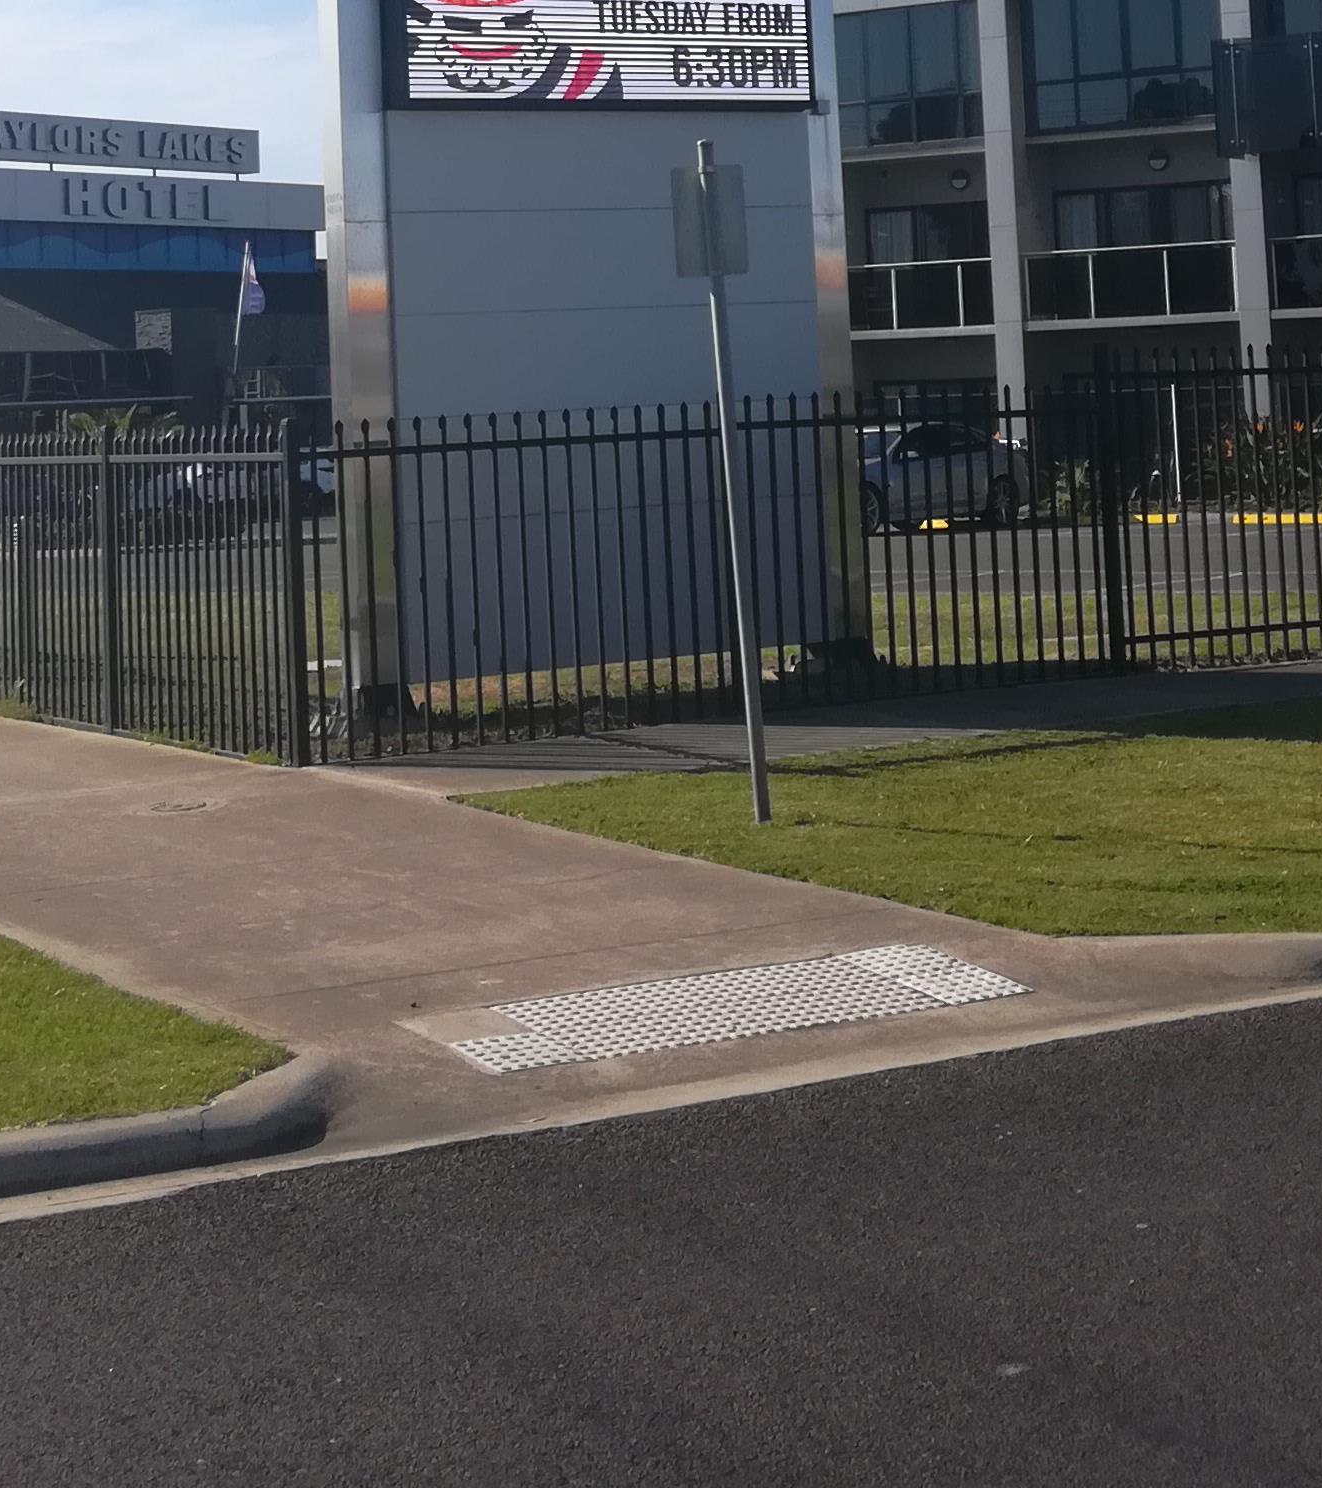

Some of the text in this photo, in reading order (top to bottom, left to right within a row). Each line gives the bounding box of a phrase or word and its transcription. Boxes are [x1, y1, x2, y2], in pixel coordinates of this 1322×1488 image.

[592, 0, 794, 36] TUESDAY FROM
[673, 47, 797, 88] 6:30PM
[138, 129, 246, 165] LAKES
[62, 177, 229, 222] HOTEL
